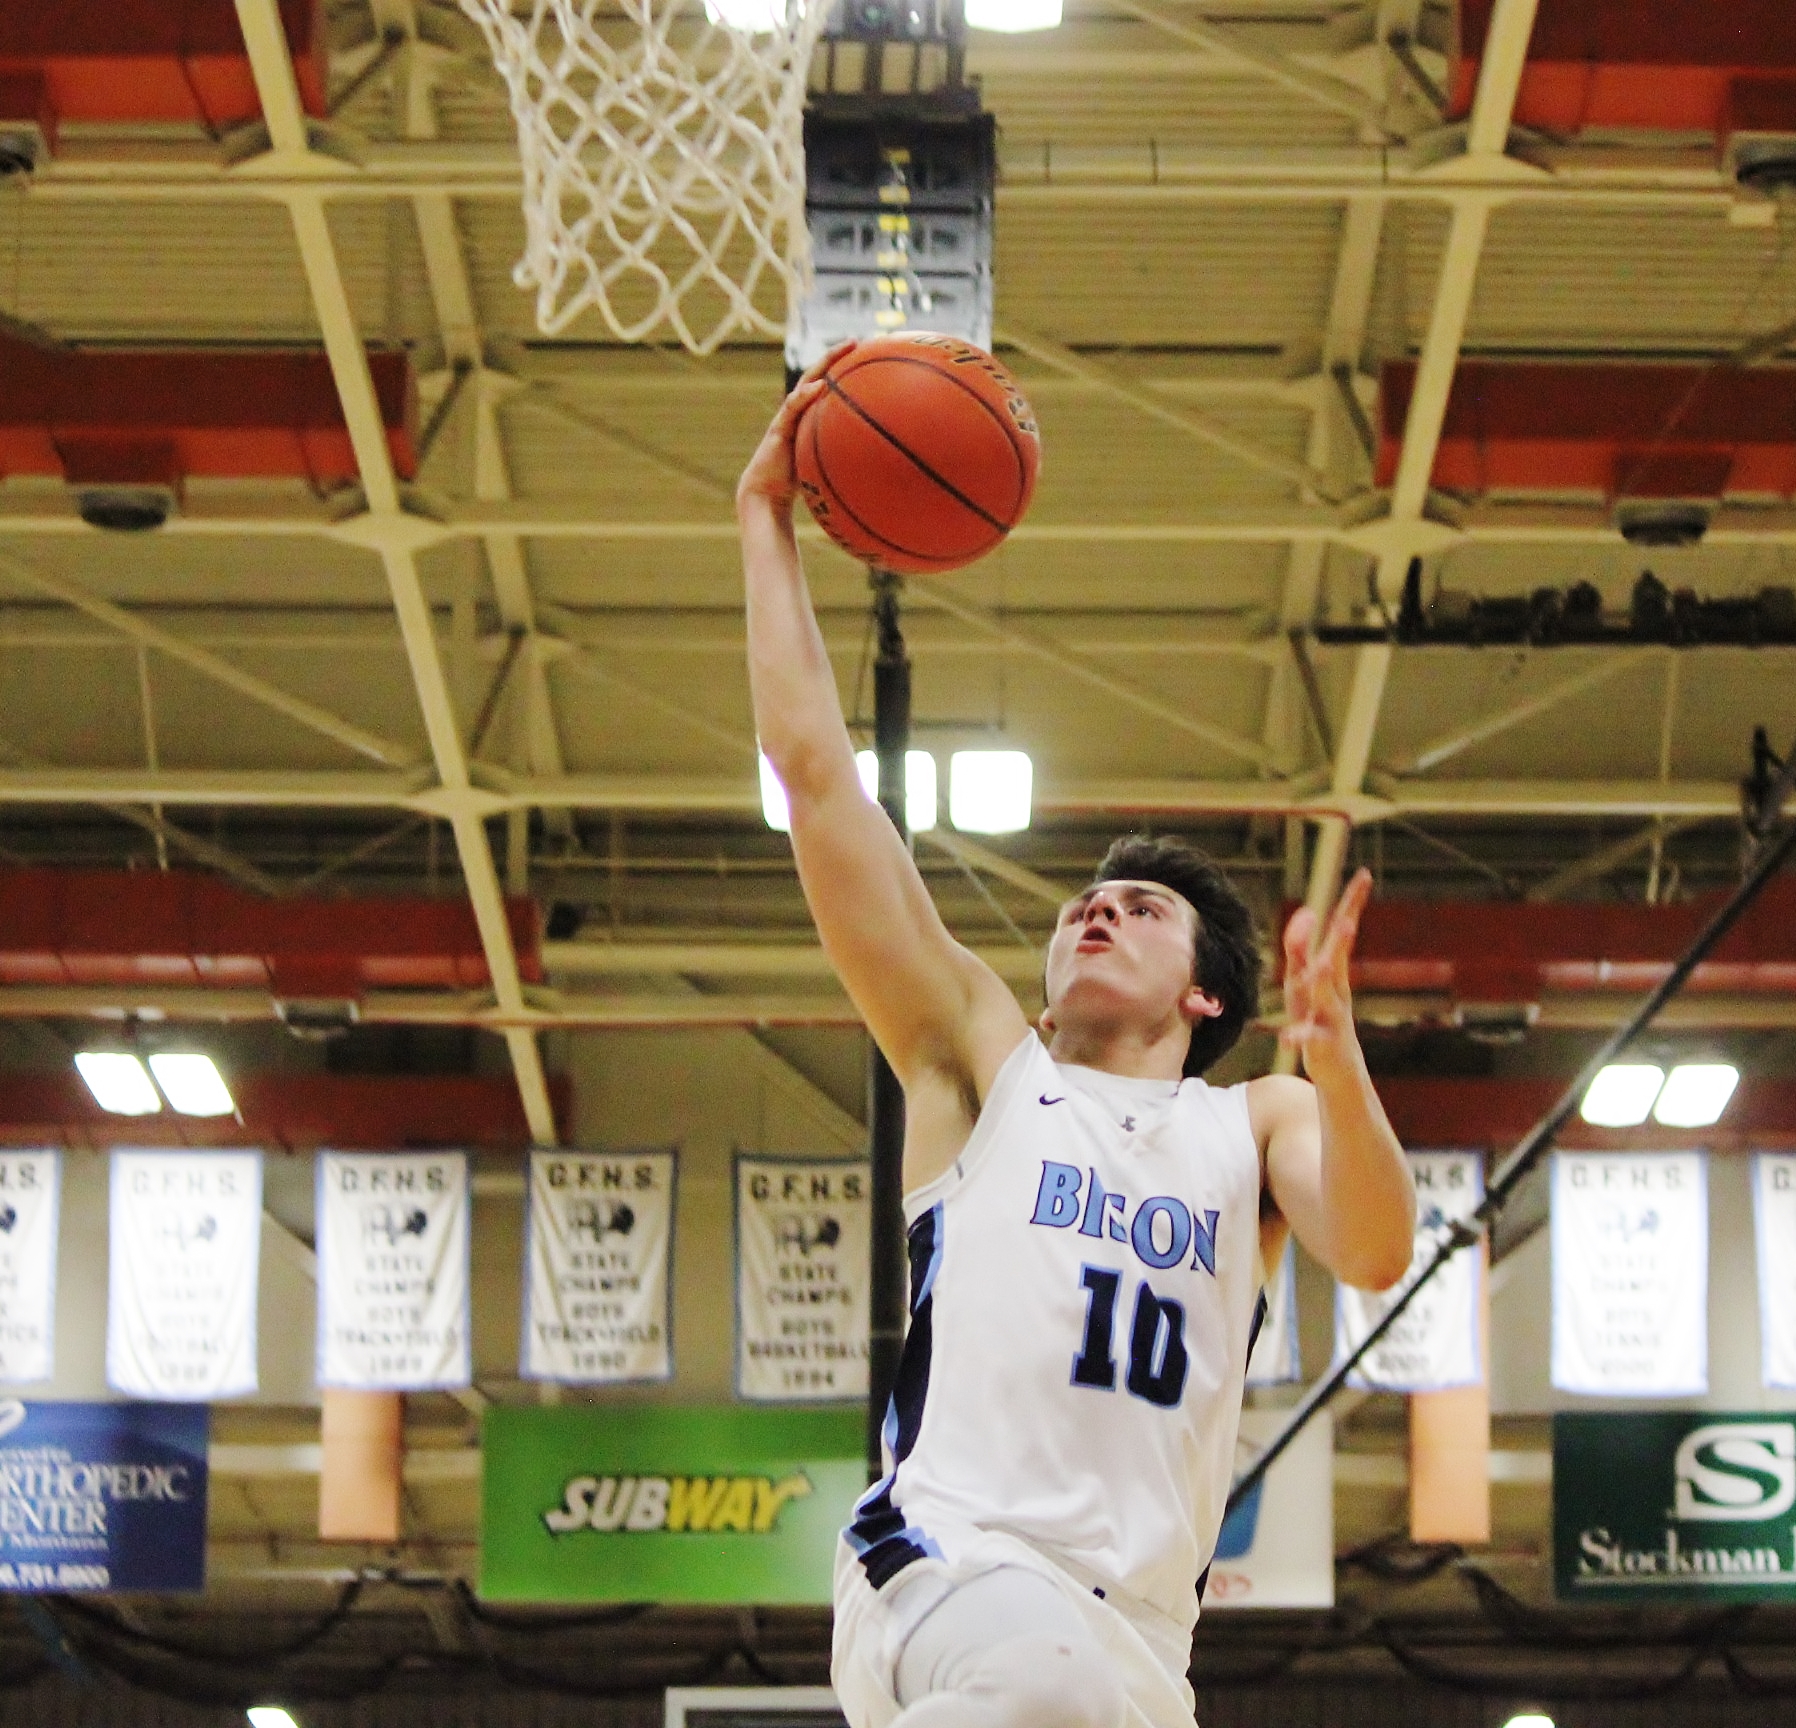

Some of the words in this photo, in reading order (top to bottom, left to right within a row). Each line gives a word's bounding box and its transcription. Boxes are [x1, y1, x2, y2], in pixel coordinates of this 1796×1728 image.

[1069, 1261, 1191, 1410] 10
[0, 1501, 108, 1534] ENTER
[541, 1473, 813, 1539] SUBWAY
[1577, 1527, 1781, 1575] Stockman
